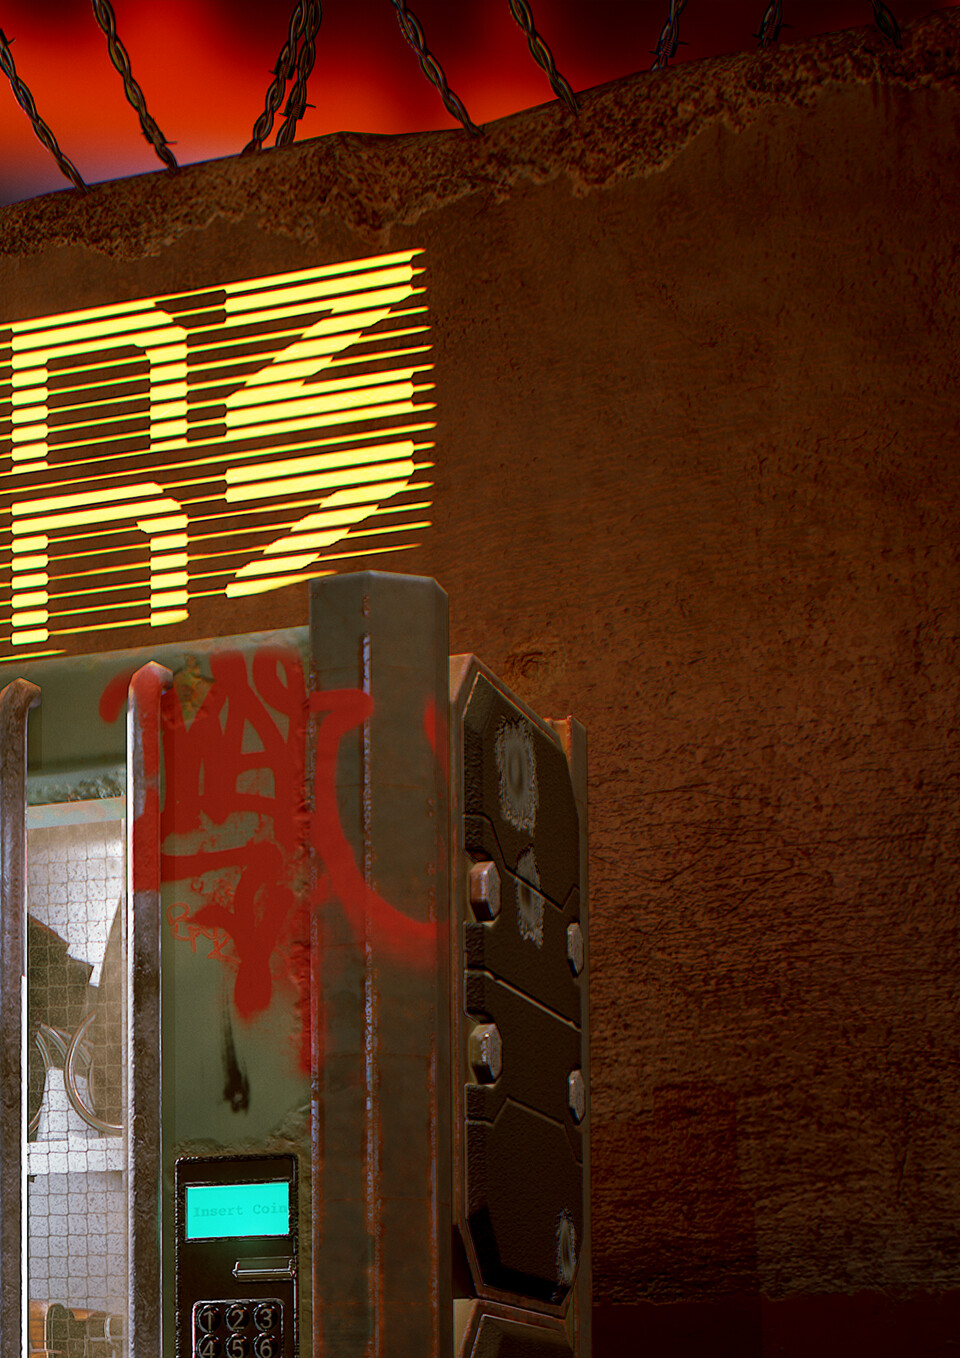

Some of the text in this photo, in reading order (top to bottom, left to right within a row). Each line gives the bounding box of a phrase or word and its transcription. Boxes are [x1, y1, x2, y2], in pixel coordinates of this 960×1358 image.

[193, 1202, 288, 1217] Insert Coin
[203, 1308, 272, 1332] 1 2 3
[260, 1339, 272, 1358] 6
